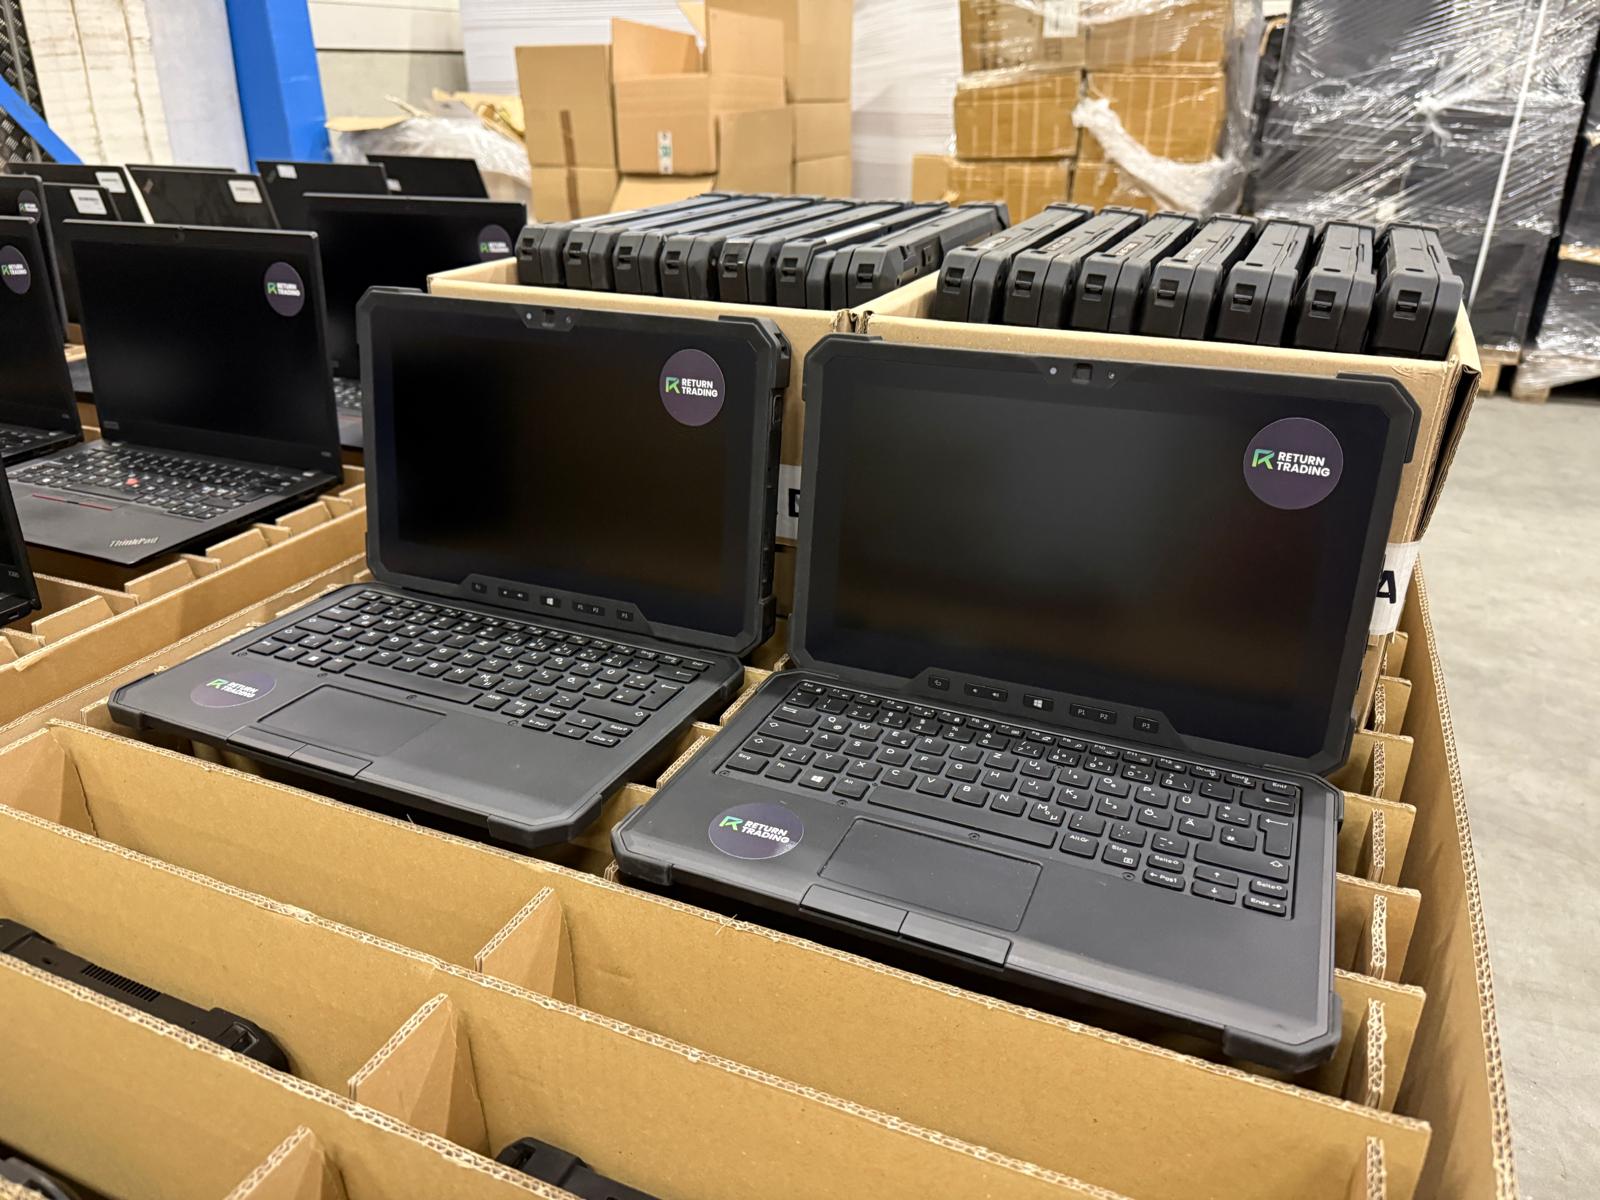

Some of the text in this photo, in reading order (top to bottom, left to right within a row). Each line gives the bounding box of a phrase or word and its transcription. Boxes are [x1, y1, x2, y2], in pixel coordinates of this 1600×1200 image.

[682, 378, 713, 388] RETURN
[682, 387, 718, 398] TRADING
[1277, 451, 1325, 466] RETURN
[1276, 461, 1331, 477] TRADING
[109, 536, 159, 548] ThinkPad
[1376, 570, 1397, 604] A
[745, 820, 788, 836] RETURN
[741, 826, 790, 843] TRADING
[1112, 844, 1128, 854] Strg
[1160, 874, 1178, 883] Pos1
[1250, 898, 1270, 906] Ende
